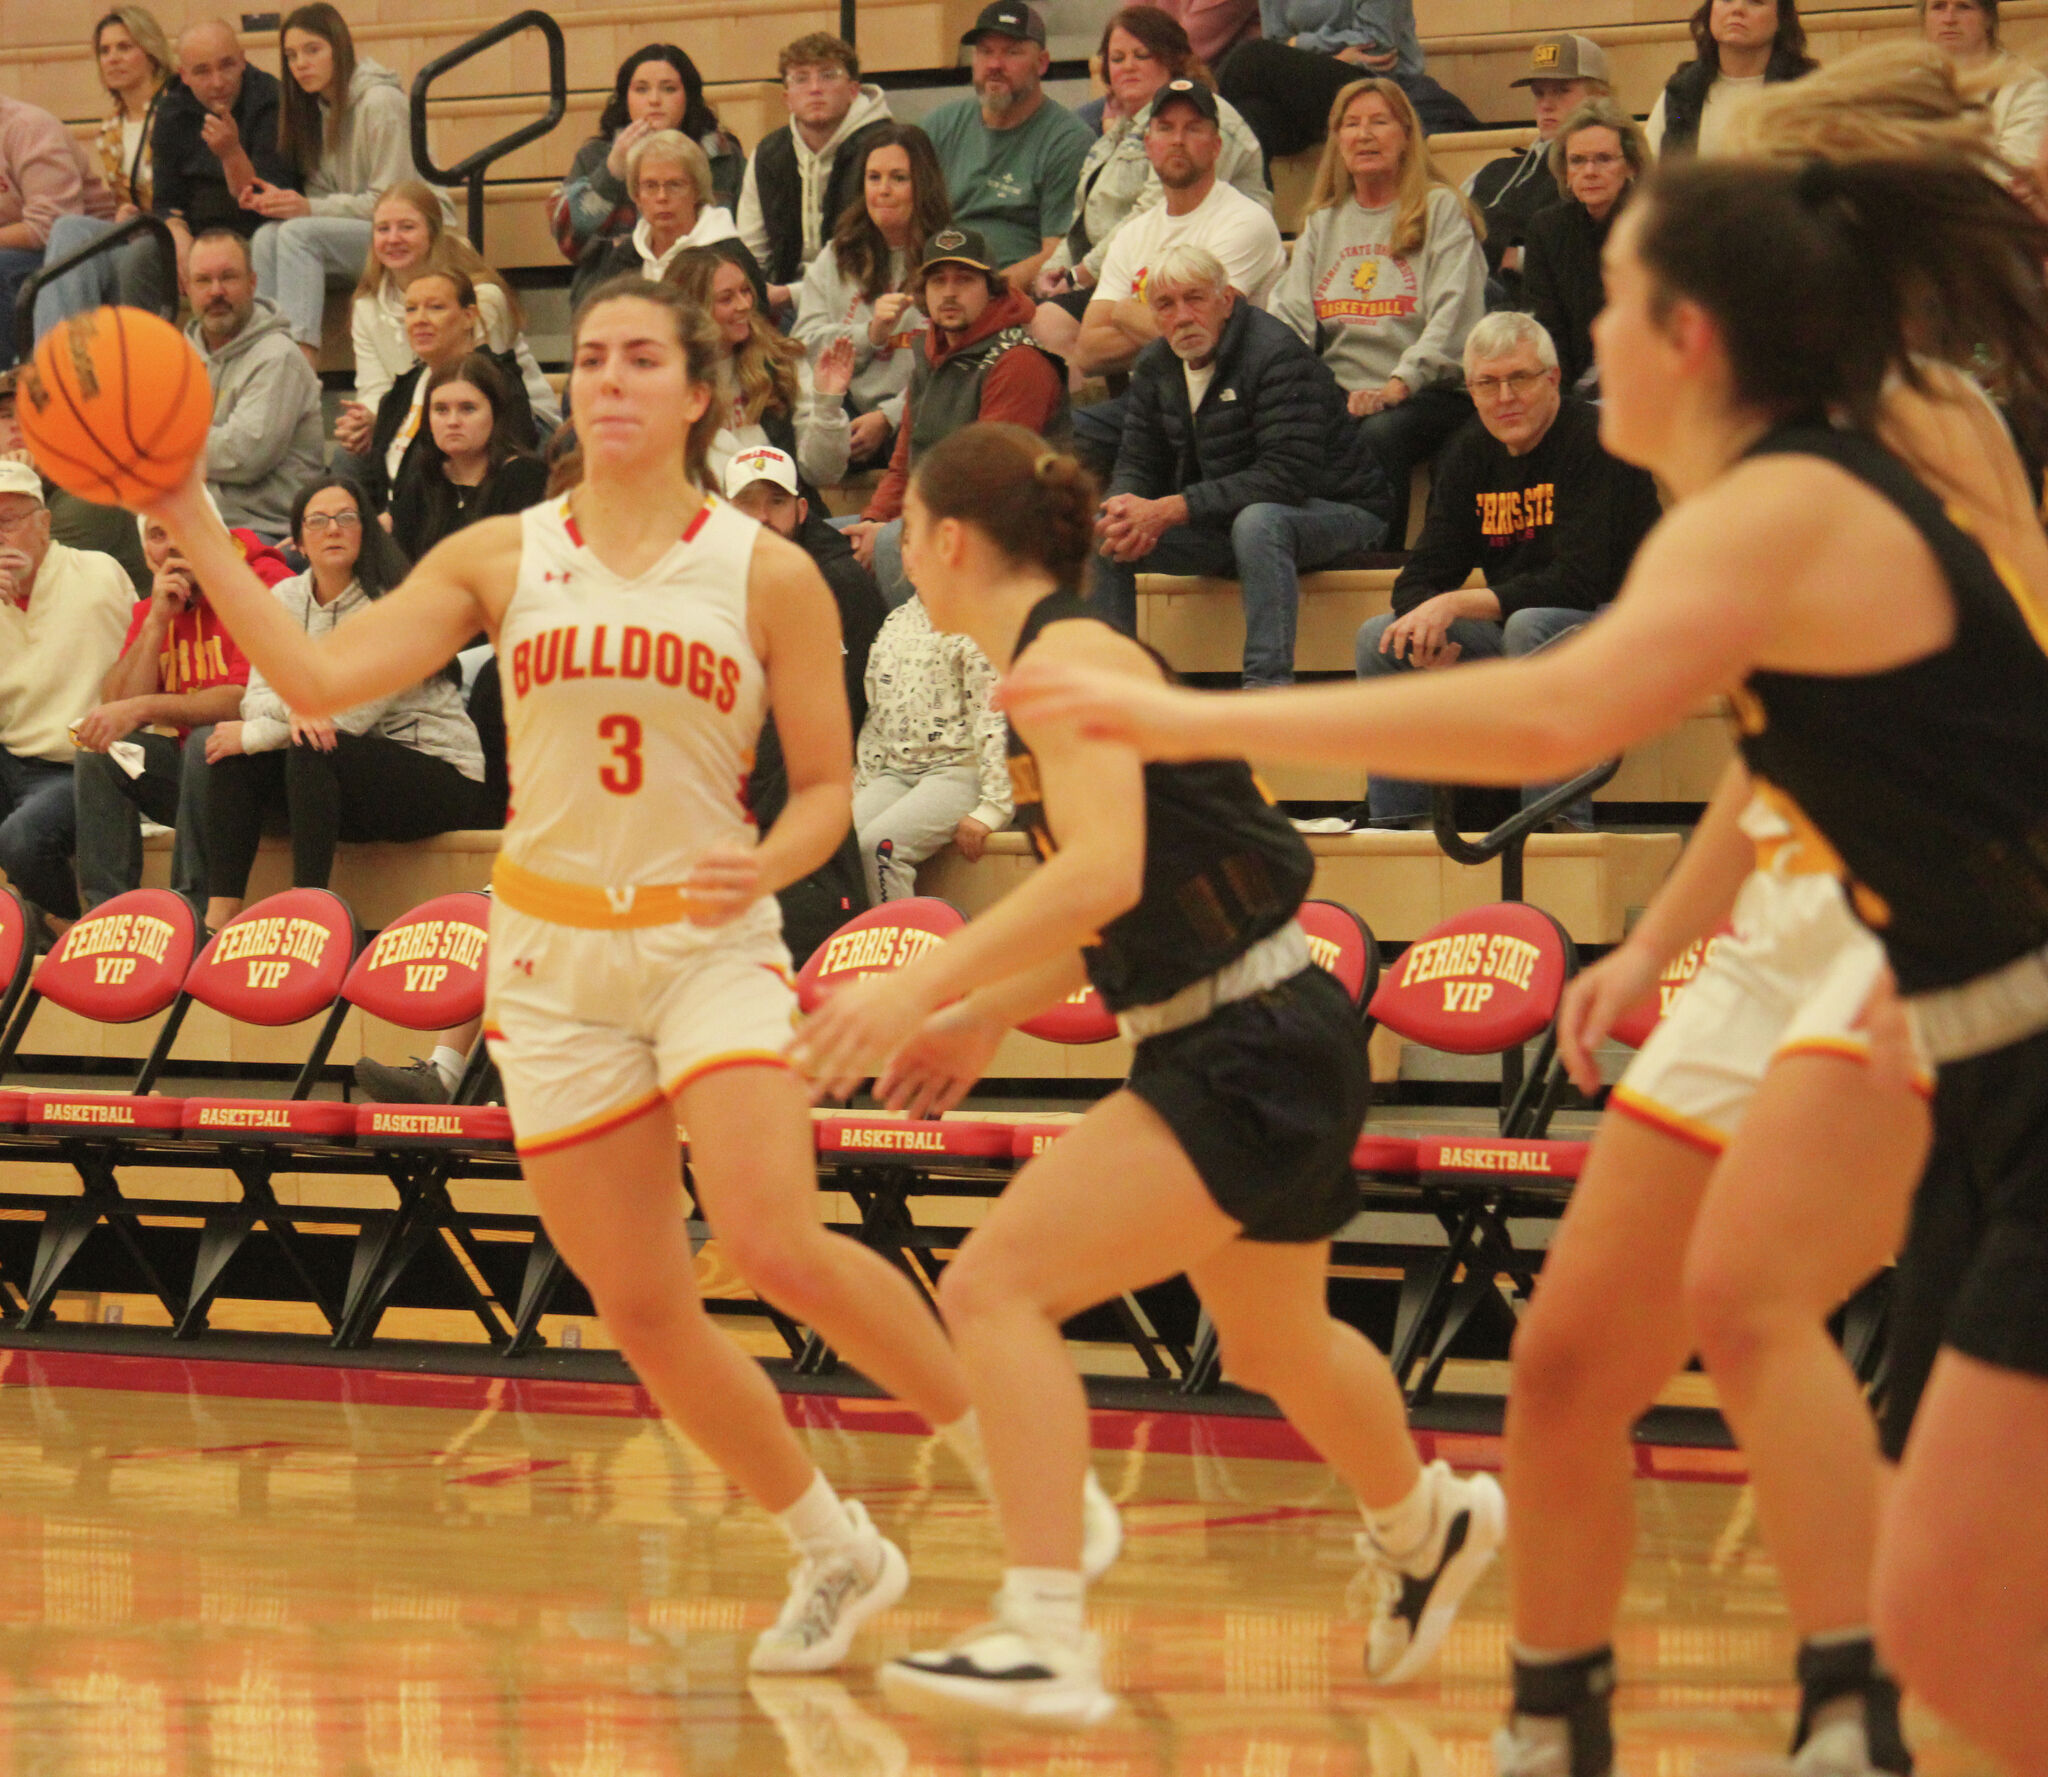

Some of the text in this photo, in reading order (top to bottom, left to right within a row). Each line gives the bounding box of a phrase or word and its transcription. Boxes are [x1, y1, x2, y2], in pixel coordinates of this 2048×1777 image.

[512, 625, 741, 715] BULLDOGS
[598, 713, 644, 797] 3
[60, 914, 176, 965] FERRIS STATE
[210, 917, 331, 968] FERRIS STATE
[367, 920, 488, 971] FERRIS STATE
[817, 926, 899, 977] FERRIS
[94, 957, 136, 984] VIP
[246, 960, 290, 988] VIP
[1400, 933, 1541, 991] FERRIS STATE
[403, 964, 448, 992] VIP
[1442, 981, 1494, 1012] VIP
[43, 1104, 135, 1124] BASKETBALL
[373, 1113, 464, 1134] BASKETBALL
[840, 1128, 945, 1150] BASKETBALL
[1439, 1147, 1551, 1172] BASKETBALL
